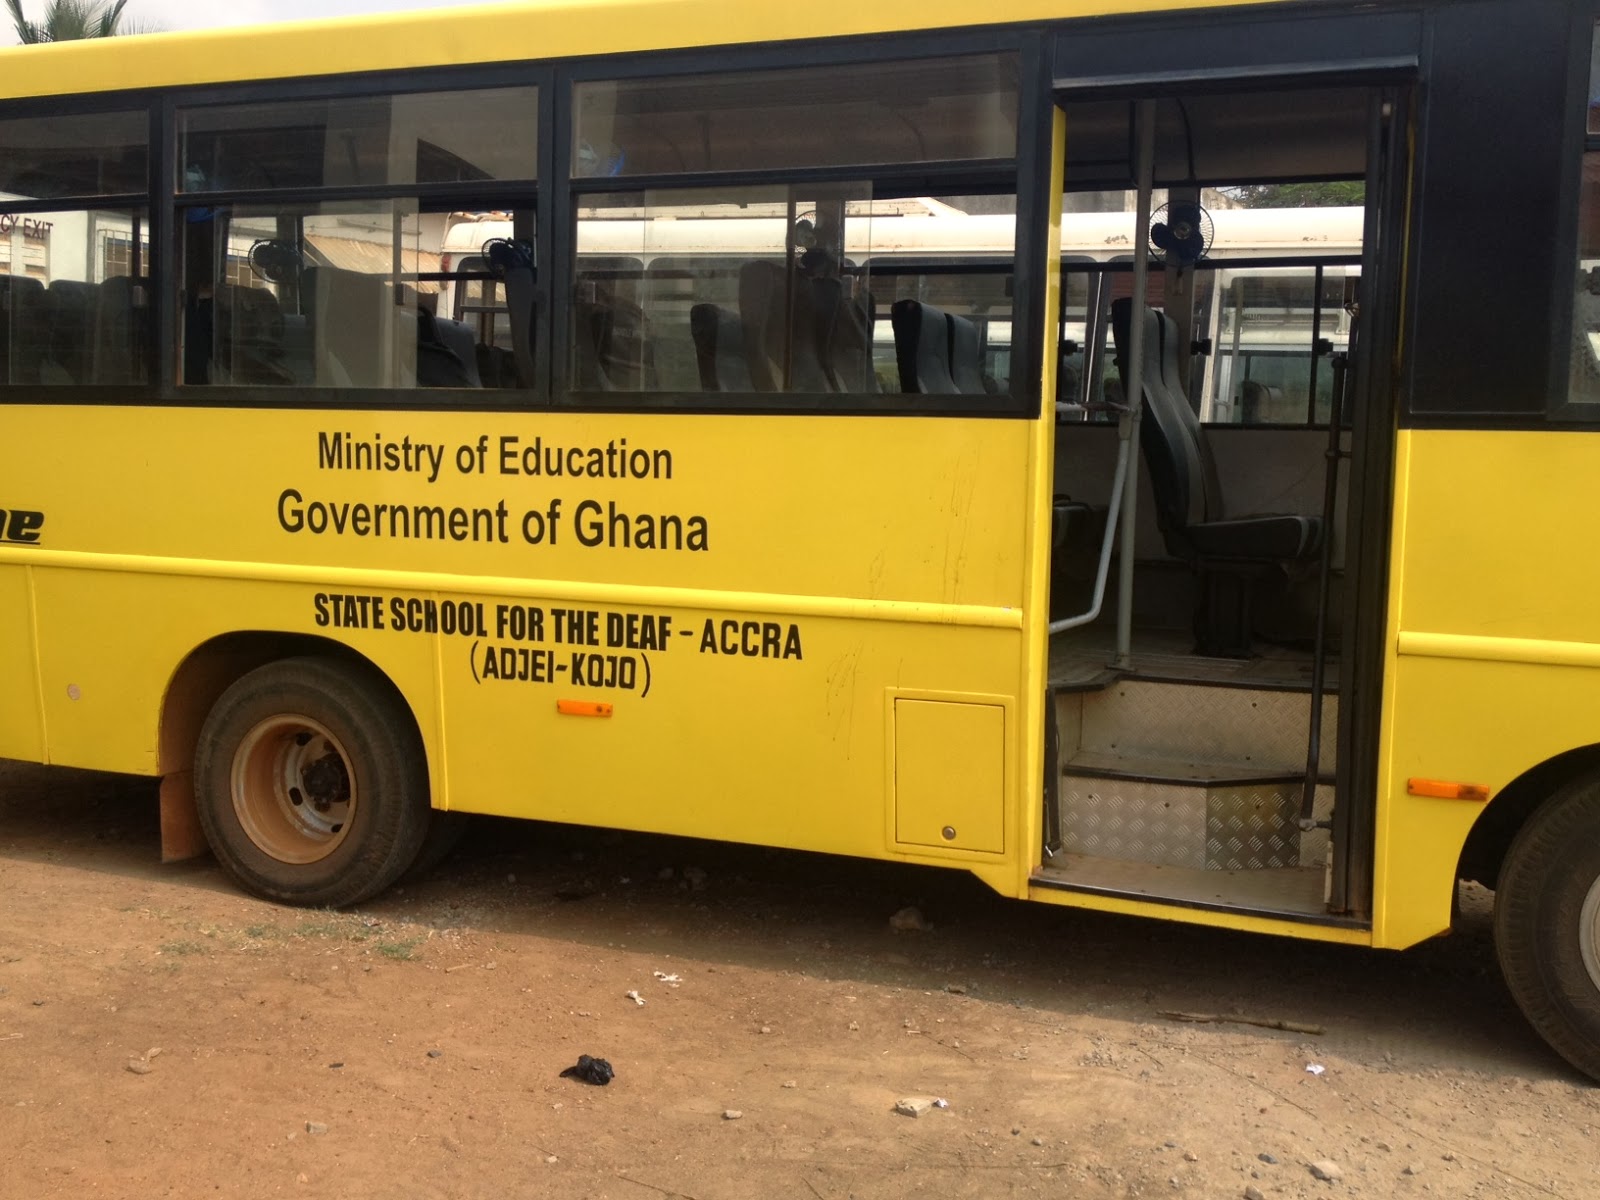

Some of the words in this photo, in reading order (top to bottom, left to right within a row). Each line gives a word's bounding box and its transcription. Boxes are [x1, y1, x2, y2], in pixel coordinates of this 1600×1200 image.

[23, 217, 53, 239] EXIT
[319, 432, 443, 482] Ministry
[456, 436, 487, 475] of
[500, 436, 672, 478] Education
[277, 489, 508, 543] Government
[523, 499, 561, 544] of
[575, 500, 709, 551] Ghana
[314, 593, 385, 630] STATE
[390, 597, 488, 640] SCHOOL
[497, 605, 543, 642] FOR
[551, 609, 600, 646] THE
[606, 612, 672, 651] DEAF
[699, 618, 803, 660] ACCRA
[470, 641, 651, 698] (ADJEI-KOJO)
